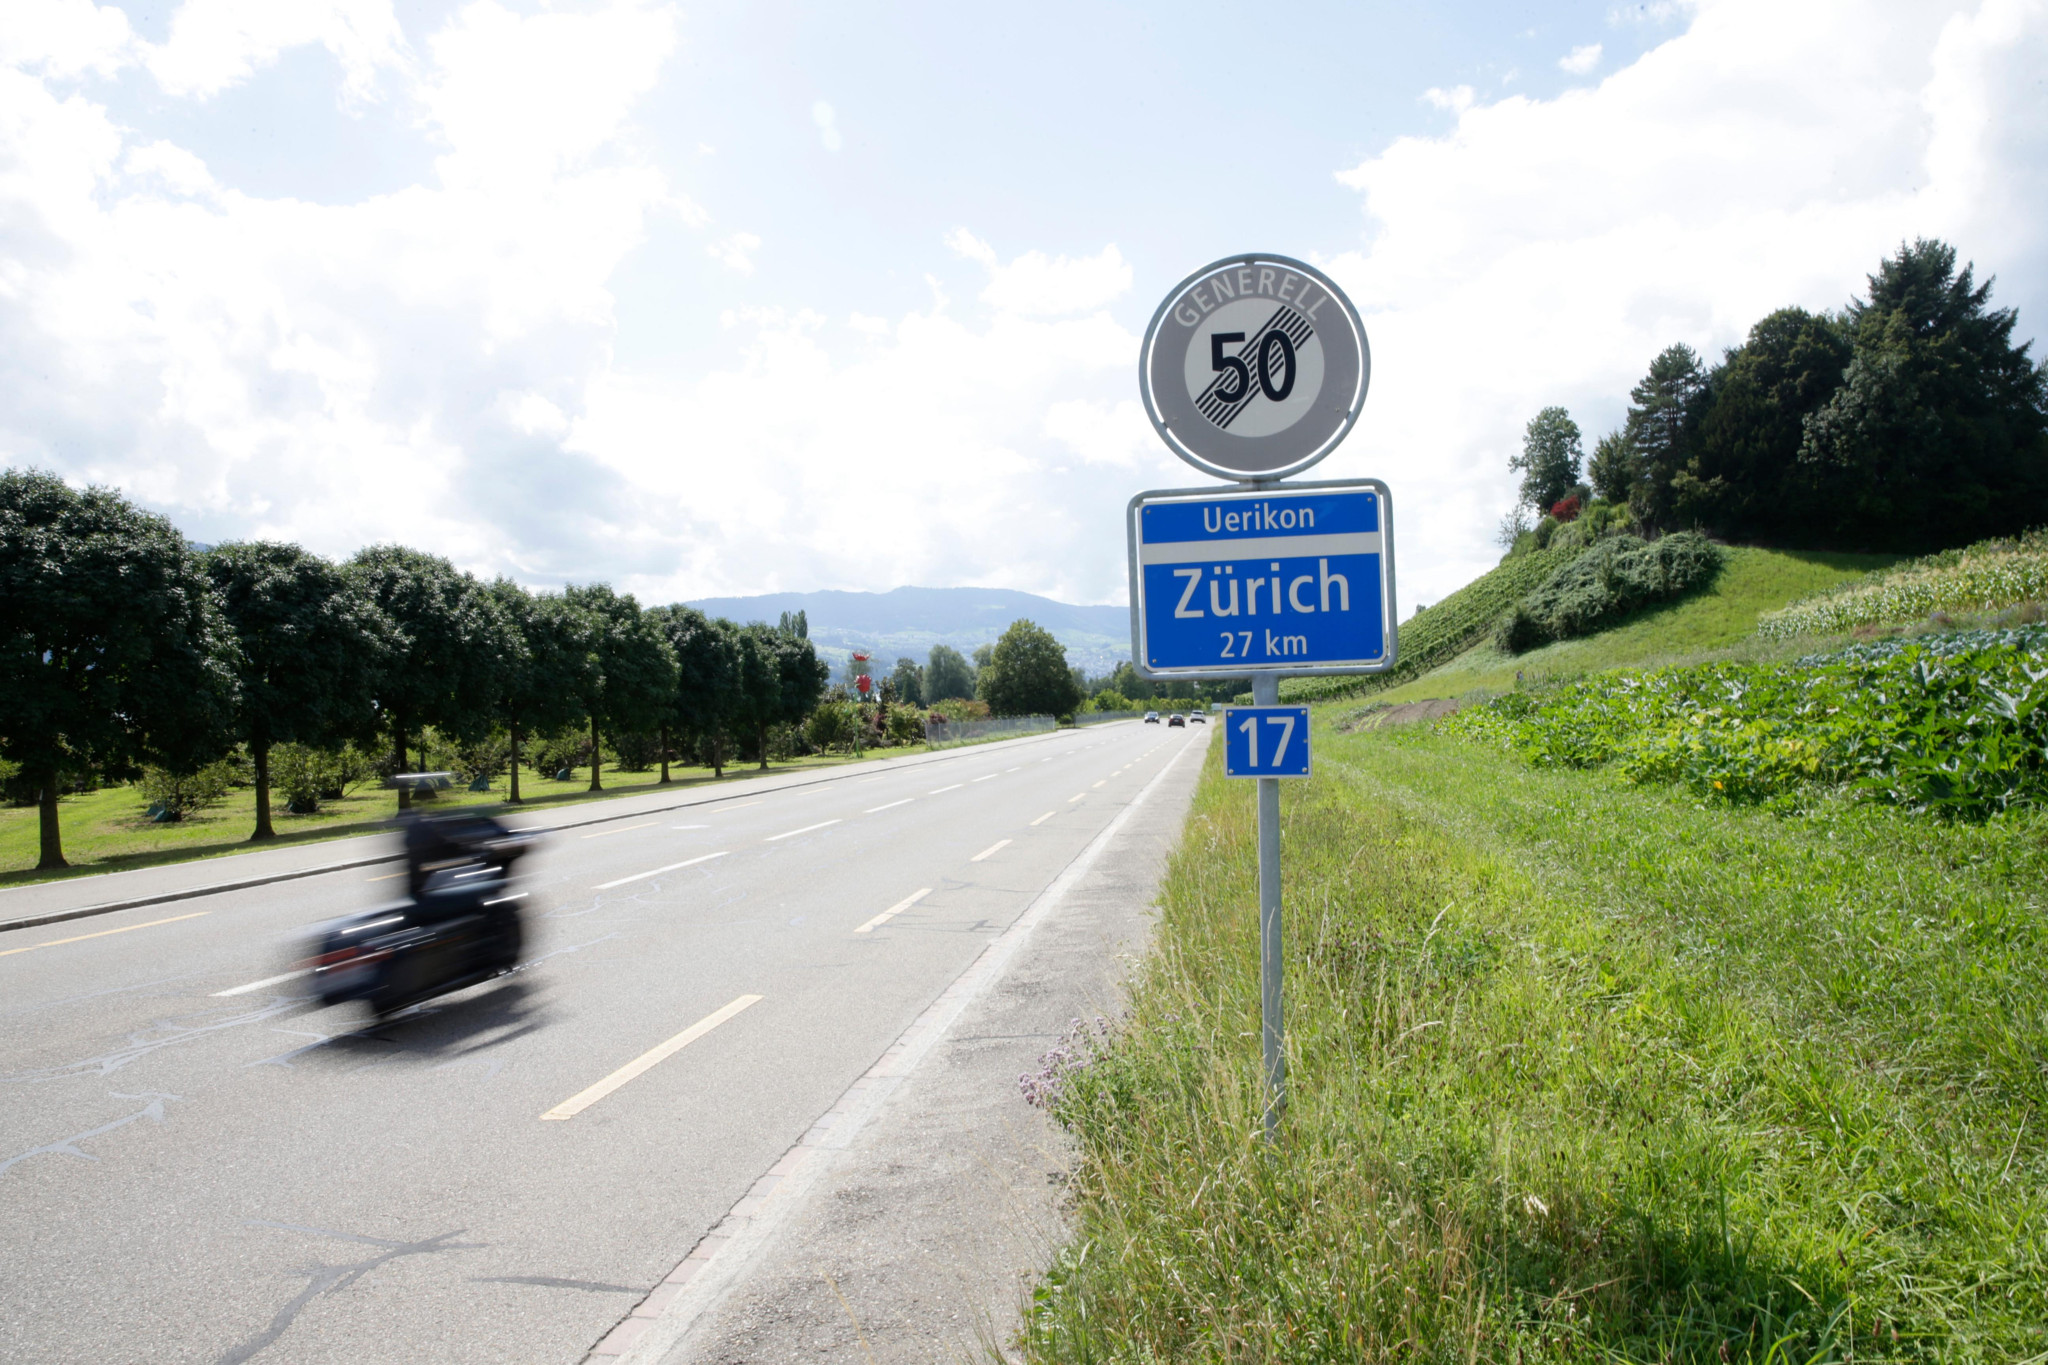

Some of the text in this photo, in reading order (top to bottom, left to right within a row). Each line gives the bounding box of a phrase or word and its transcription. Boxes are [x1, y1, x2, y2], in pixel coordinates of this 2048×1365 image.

[1174, 268, 1327, 327] GENERELL
[1211, 329, 1296, 403] 50
[1203, 502, 1315, 533] Uerikon
[1173, 558, 1349, 618] Zürich
[1220, 629, 1308, 658] 27 km
[1239, 716, 1295, 768] 17
